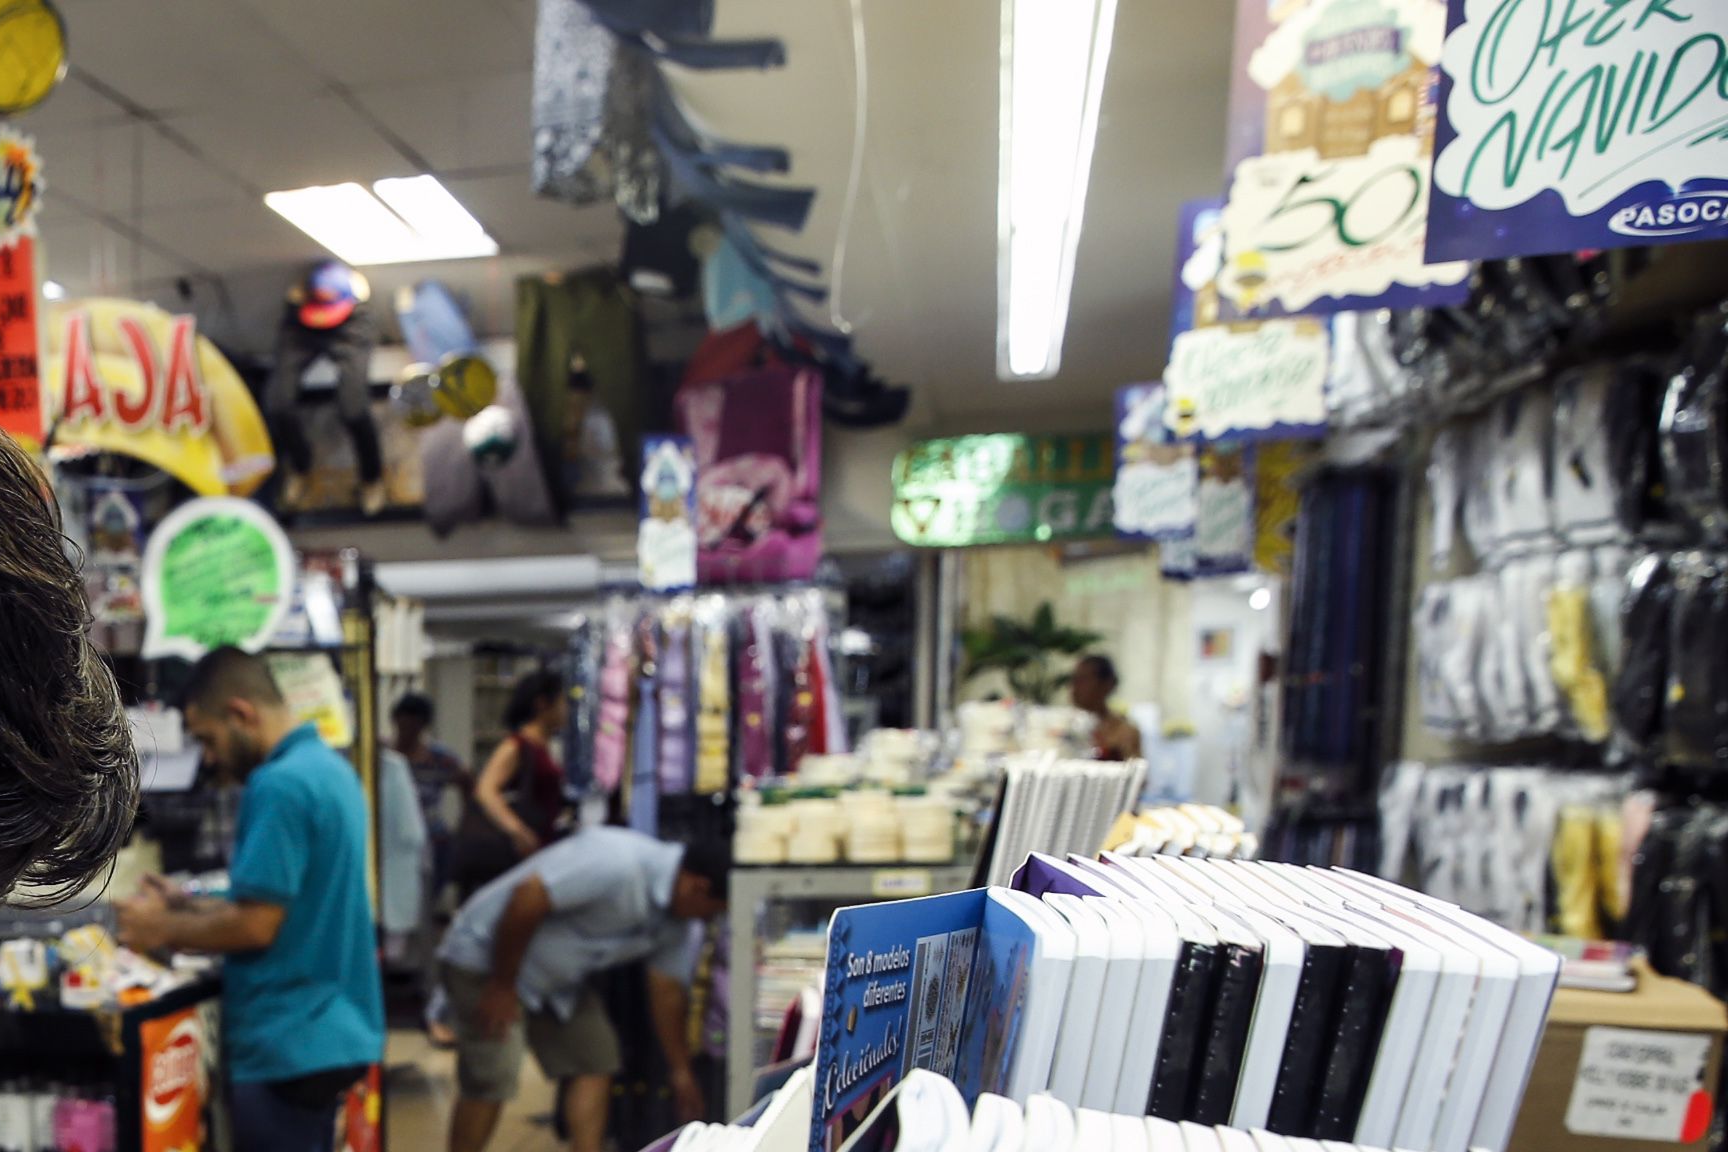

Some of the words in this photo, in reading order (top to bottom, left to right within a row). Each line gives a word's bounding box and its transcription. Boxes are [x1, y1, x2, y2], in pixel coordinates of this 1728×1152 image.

[1461, 33, 1728, 197] NAVID
[846, 951, 865, 978] Son
[865, 950, 873, 972] 8
[873, 944, 910, 972] modelos
[863, 979, 907, 1008] diferentes
